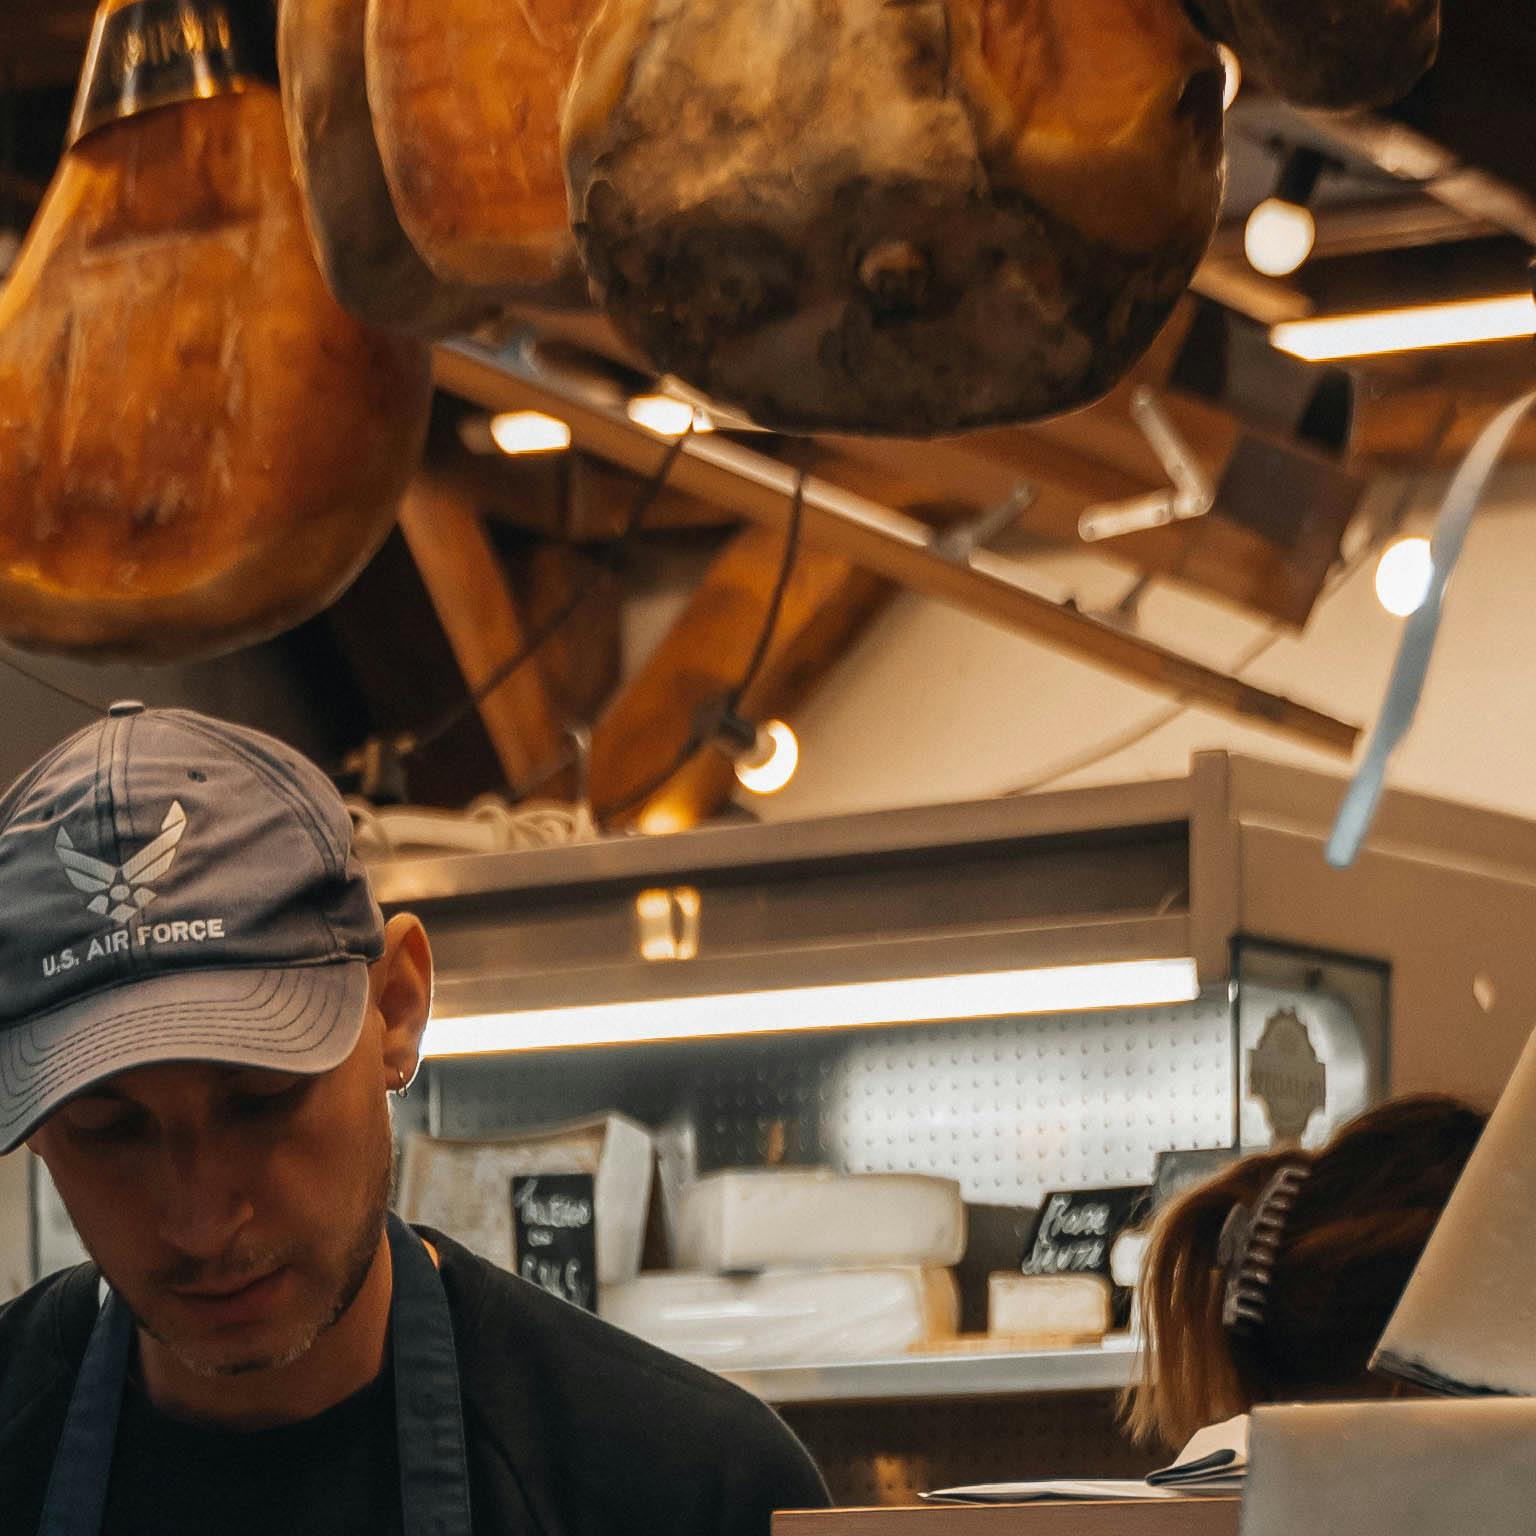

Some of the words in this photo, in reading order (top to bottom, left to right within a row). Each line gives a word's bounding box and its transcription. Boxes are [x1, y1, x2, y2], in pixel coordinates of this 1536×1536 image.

[42, 949, 80, 977] U.S.
[87, 929, 130, 961] AIR
[136, 917, 225, 946] FORCE
